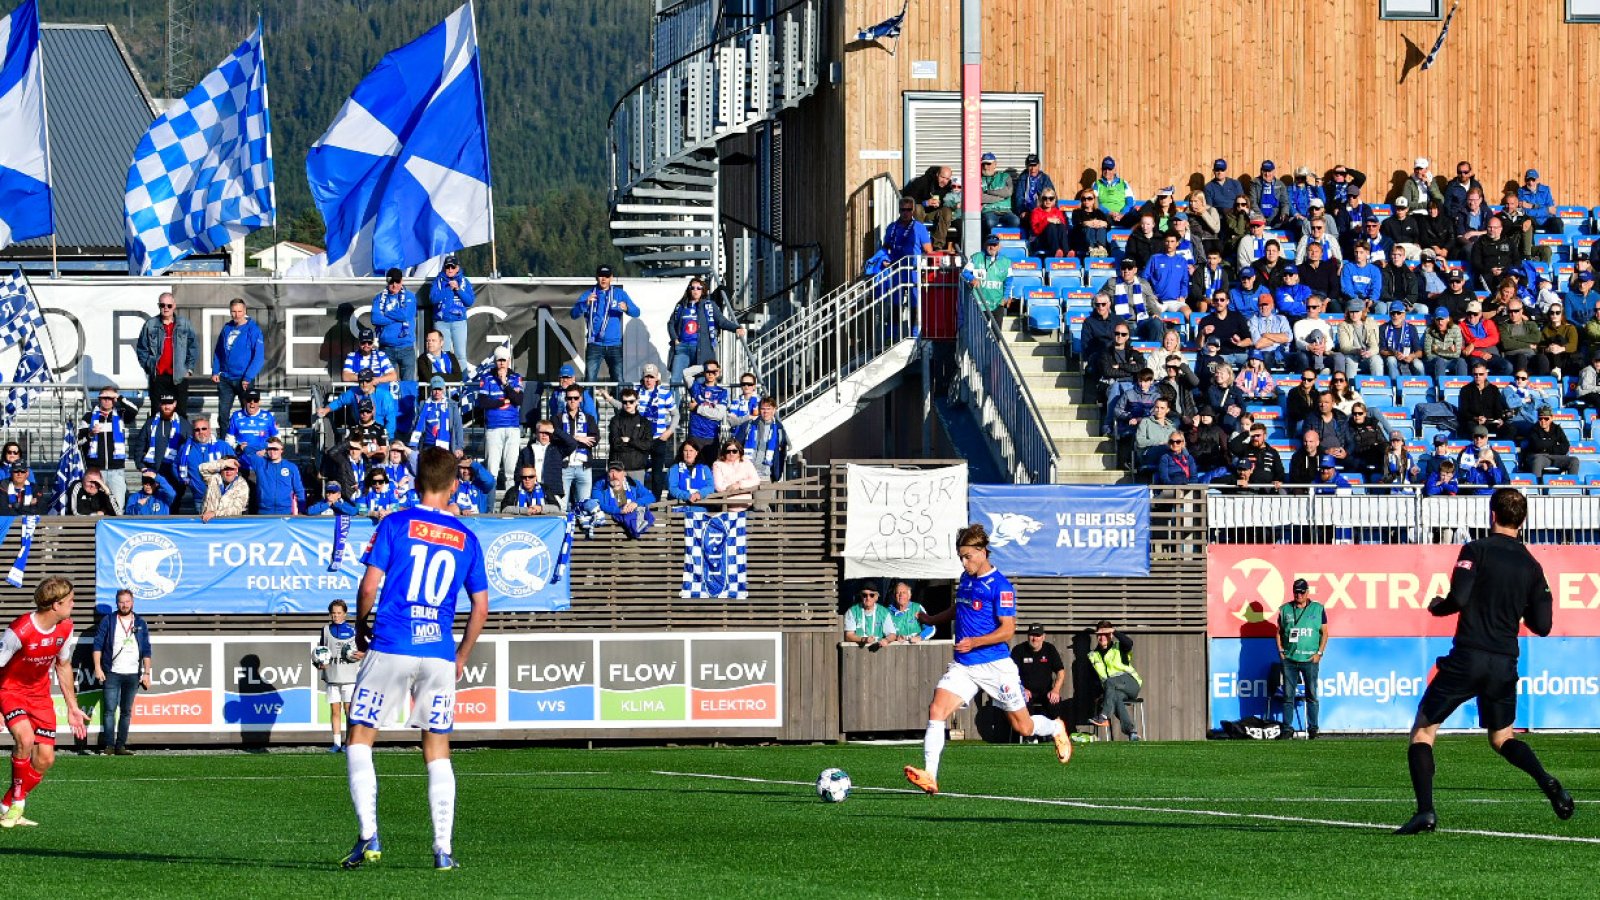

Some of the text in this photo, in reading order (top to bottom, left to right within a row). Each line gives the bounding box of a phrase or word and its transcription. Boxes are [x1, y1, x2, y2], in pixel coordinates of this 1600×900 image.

[860, 476, 956, 508] VI GIR
[879, 510, 934, 537] OSS
[1056, 512, 1137, 526] VI GIR OSS
[430, 530, 459, 543] EXTRA
[1056, 528, 1135, 548] ALDRI!
[208, 542, 308, 568] FORZA
[860, 533, 952, 564] ALDRI
[247, 576, 313, 590] FOLKET
[318, 576, 352, 590] FRA
[406, 544, 456, 607] 10
[233, 664, 303, 686] FLOW
[516, 662, 585, 683] FLOW
[608, 662, 677, 682] FLOW
[700, 660, 767, 681] FLOW
[1213, 670, 1423, 703] EiensMegler
[134, 704, 203, 716] ELEKTRO
[253, 703, 283, 715] VVS
[354, 703, 380, 721] ZK
[536, 700, 566, 712] VVS
[620, 700, 666, 712] KLIMA
[700, 699, 767, 712] ELEKTRO
